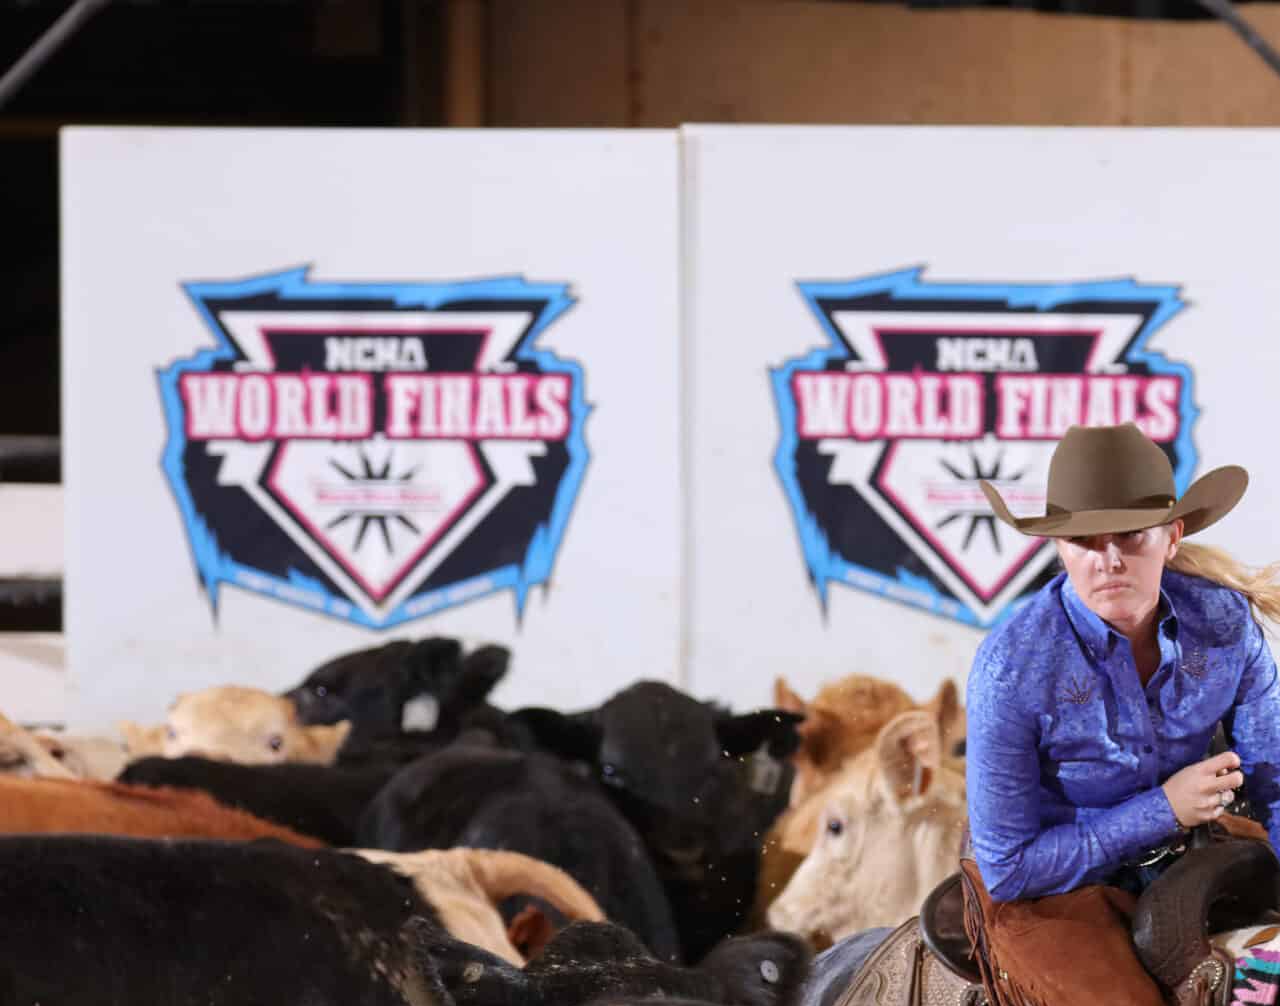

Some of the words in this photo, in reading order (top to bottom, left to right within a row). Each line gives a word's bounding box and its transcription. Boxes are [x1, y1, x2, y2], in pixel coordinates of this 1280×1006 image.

[179, 373, 373, 442] WORLD
[383, 373, 573, 440] FINALS
[792, 373, 985, 441] WORLD
[996, 373, 1183, 441] FINALS
